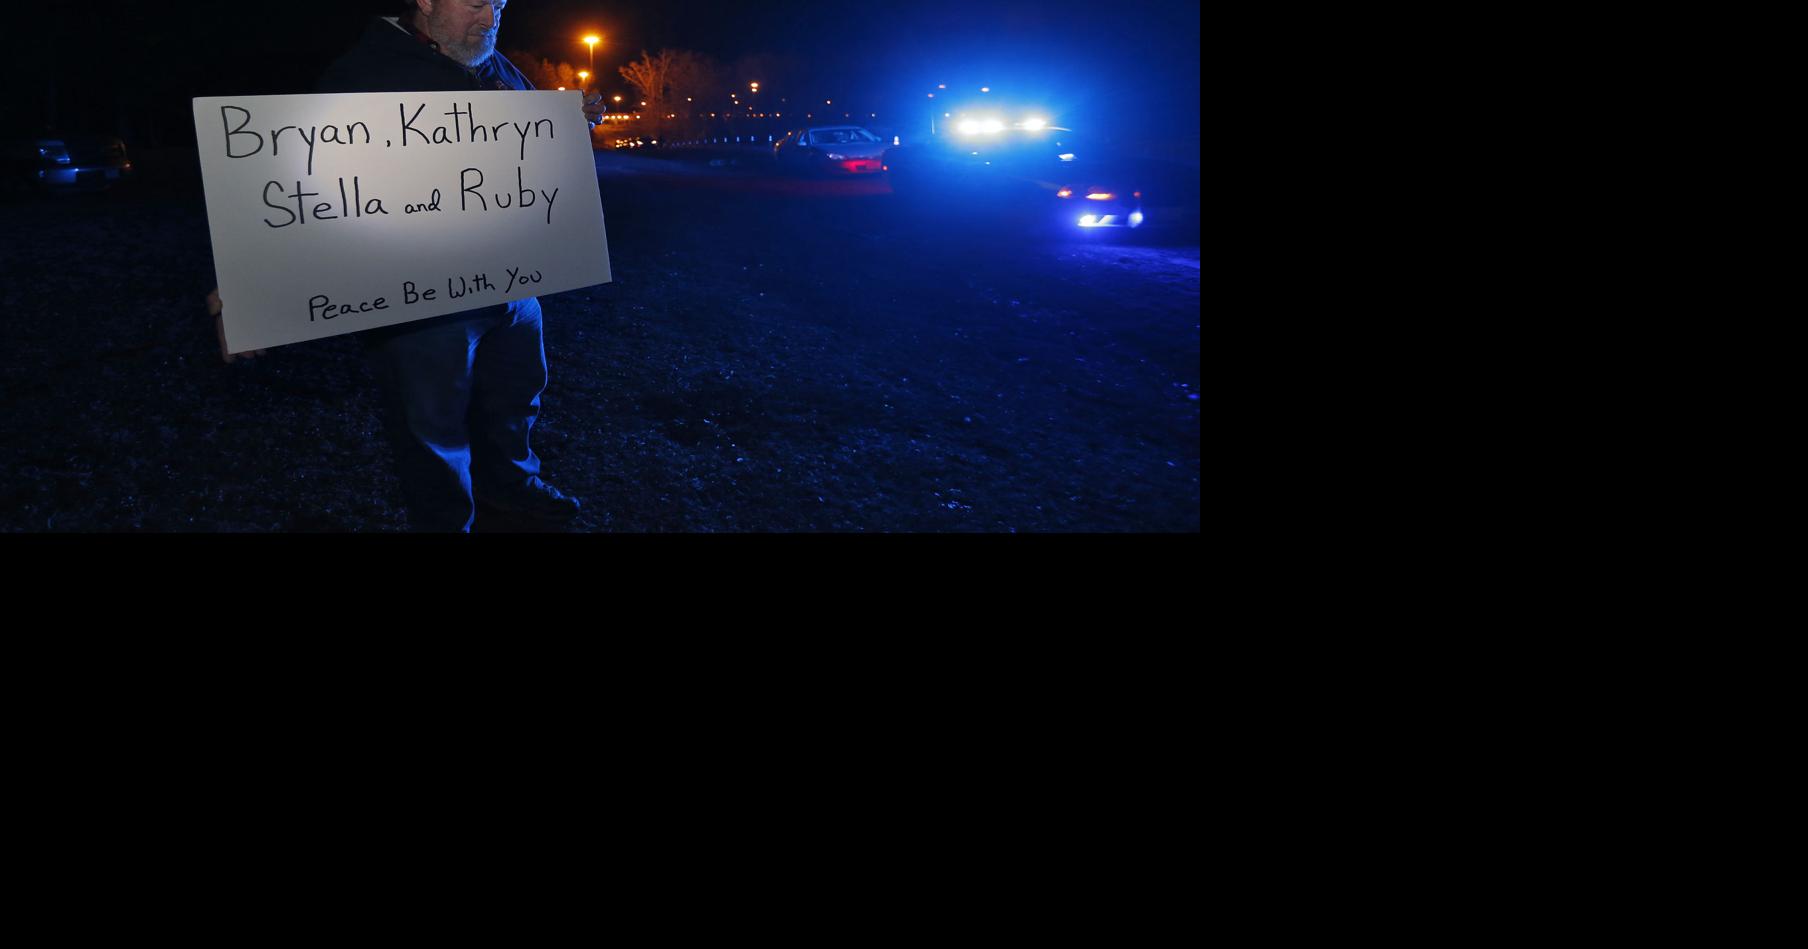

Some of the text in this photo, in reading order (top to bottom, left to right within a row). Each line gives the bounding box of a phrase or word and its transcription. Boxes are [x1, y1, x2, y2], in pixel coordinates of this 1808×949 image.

[262, 166, 559, 229] Stella and Ruby
[308, 266, 543, 322] Peace Be With You
